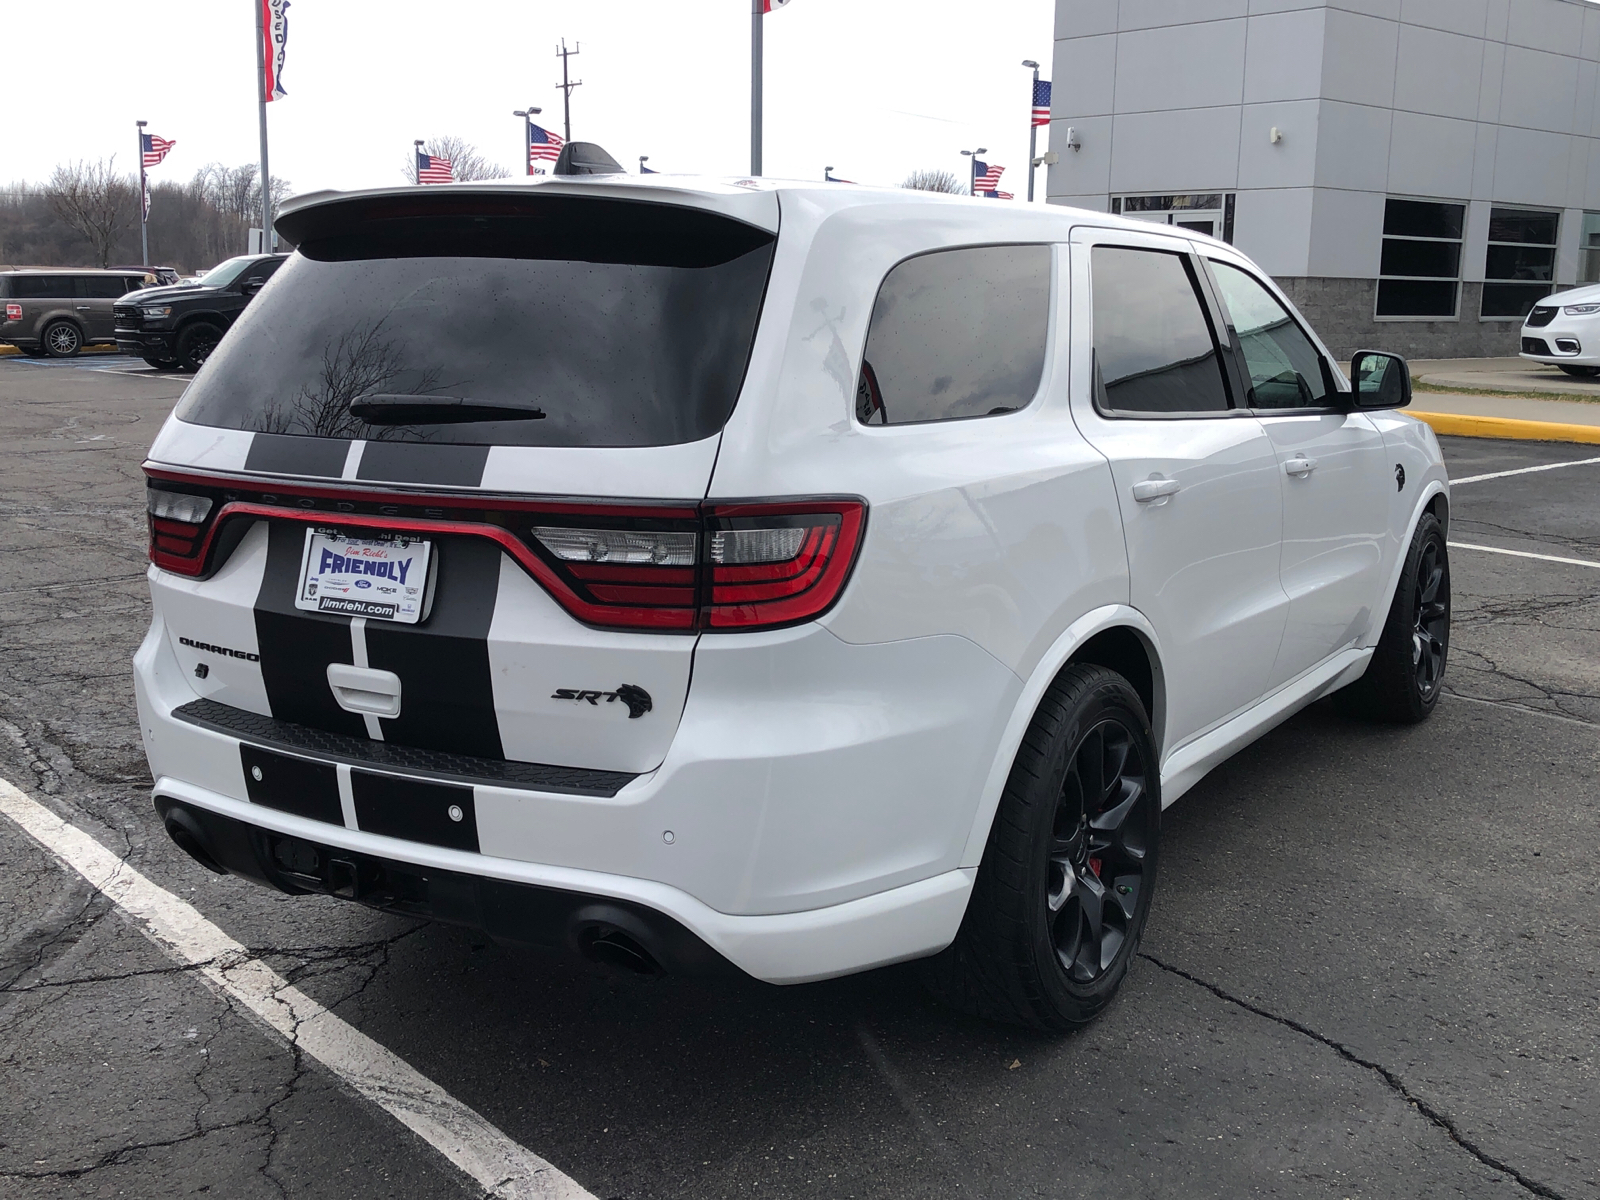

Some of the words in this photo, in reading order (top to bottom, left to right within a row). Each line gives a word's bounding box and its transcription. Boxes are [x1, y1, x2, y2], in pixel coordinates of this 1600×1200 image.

[262, 494, 443, 519] DODGE
[395, 534, 420, 543] Deal
[344, 546, 360, 557] Jim
[361, 547, 388, 559] Riehl's
[318, 547, 413, 586] FRIENDLY
[320, 597, 394, 616] jimriehl.com
[179, 637, 260, 662] DURANGO
[551, 688, 621, 706] SRT
